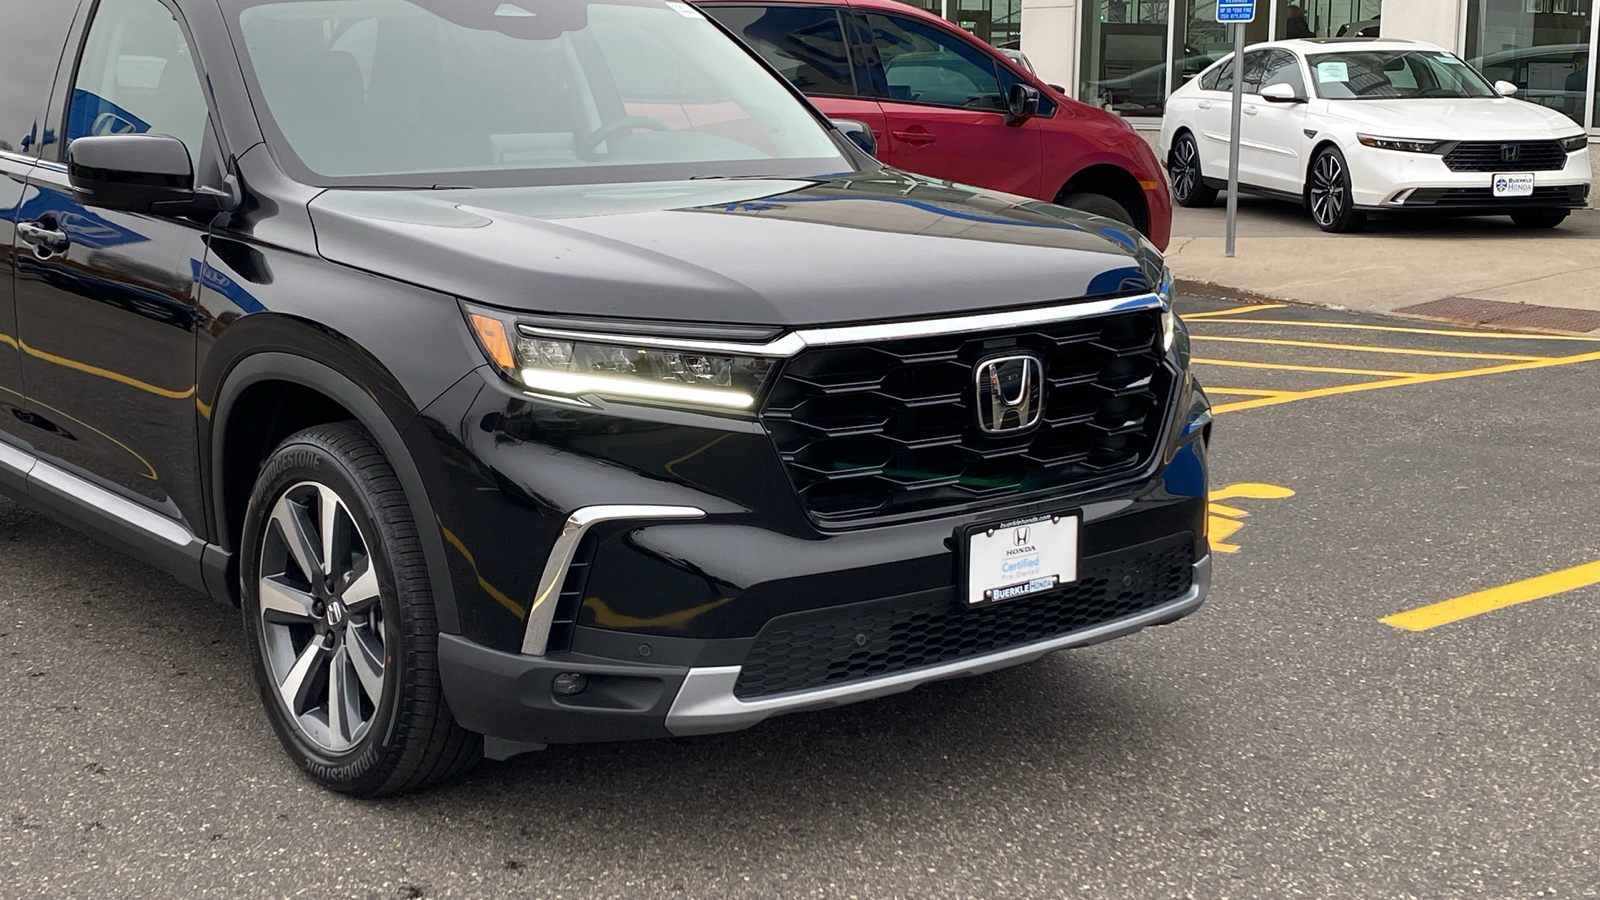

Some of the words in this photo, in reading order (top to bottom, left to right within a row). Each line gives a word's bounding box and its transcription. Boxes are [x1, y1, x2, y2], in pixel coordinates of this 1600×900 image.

[1508, 183, 1531, 191] HONDA
[1000, 514, 1052, 529] buerklehonda.com
[1006, 545, 1036, 556] HONDA
[1002, 556, 1040, 573] Certified
[1002, 568, 1039, 581] Pre-Owned
[993, 584, 1029, 600] BUERKLE
[1029, 580, 1052, 591] HONDA
[305, 741, 379, 782] BRIDGESTONE
